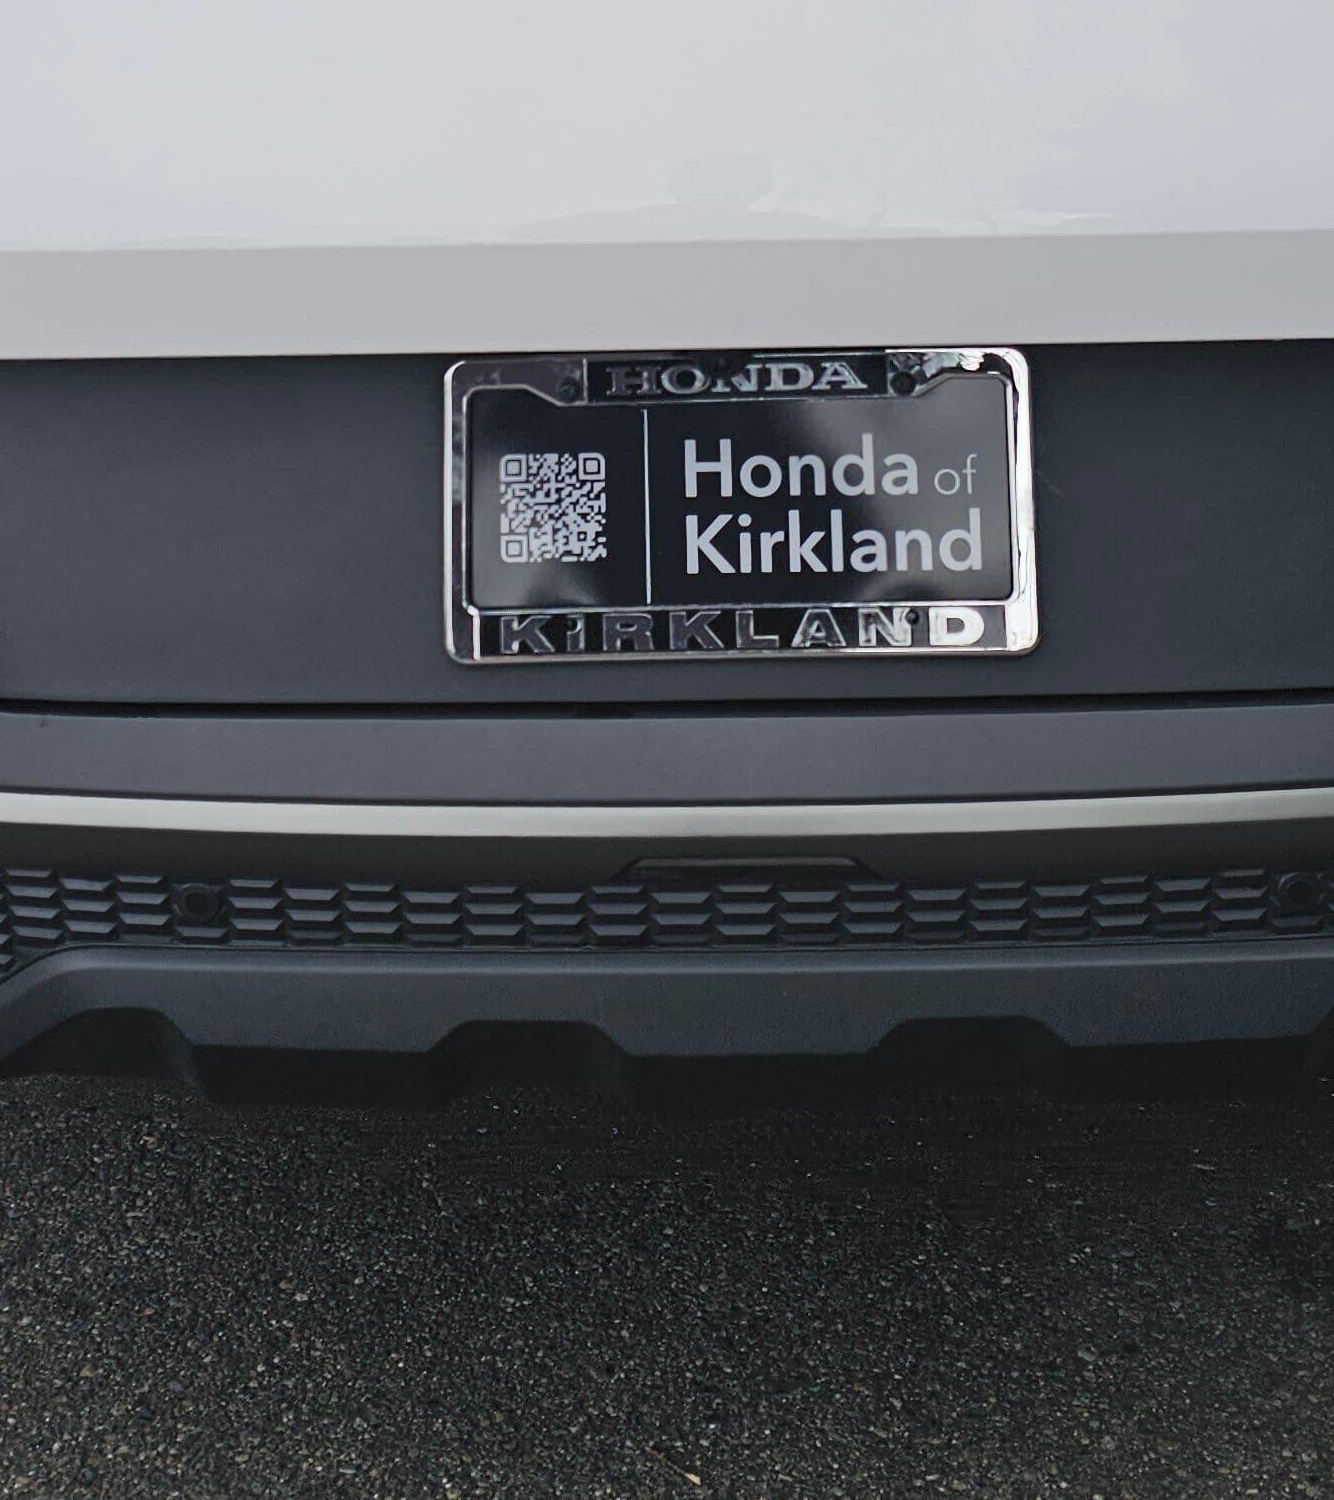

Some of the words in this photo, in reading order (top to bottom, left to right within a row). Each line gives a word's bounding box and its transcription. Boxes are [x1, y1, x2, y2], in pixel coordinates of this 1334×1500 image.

[606, 360, 867, 398] HONDA
[683, 433, 919, 498] Honda
[934, 454, 977, 496] of
[685, 508, 983, 575] Kirkland
[499, 608, 986, 656] KIRKLAND
